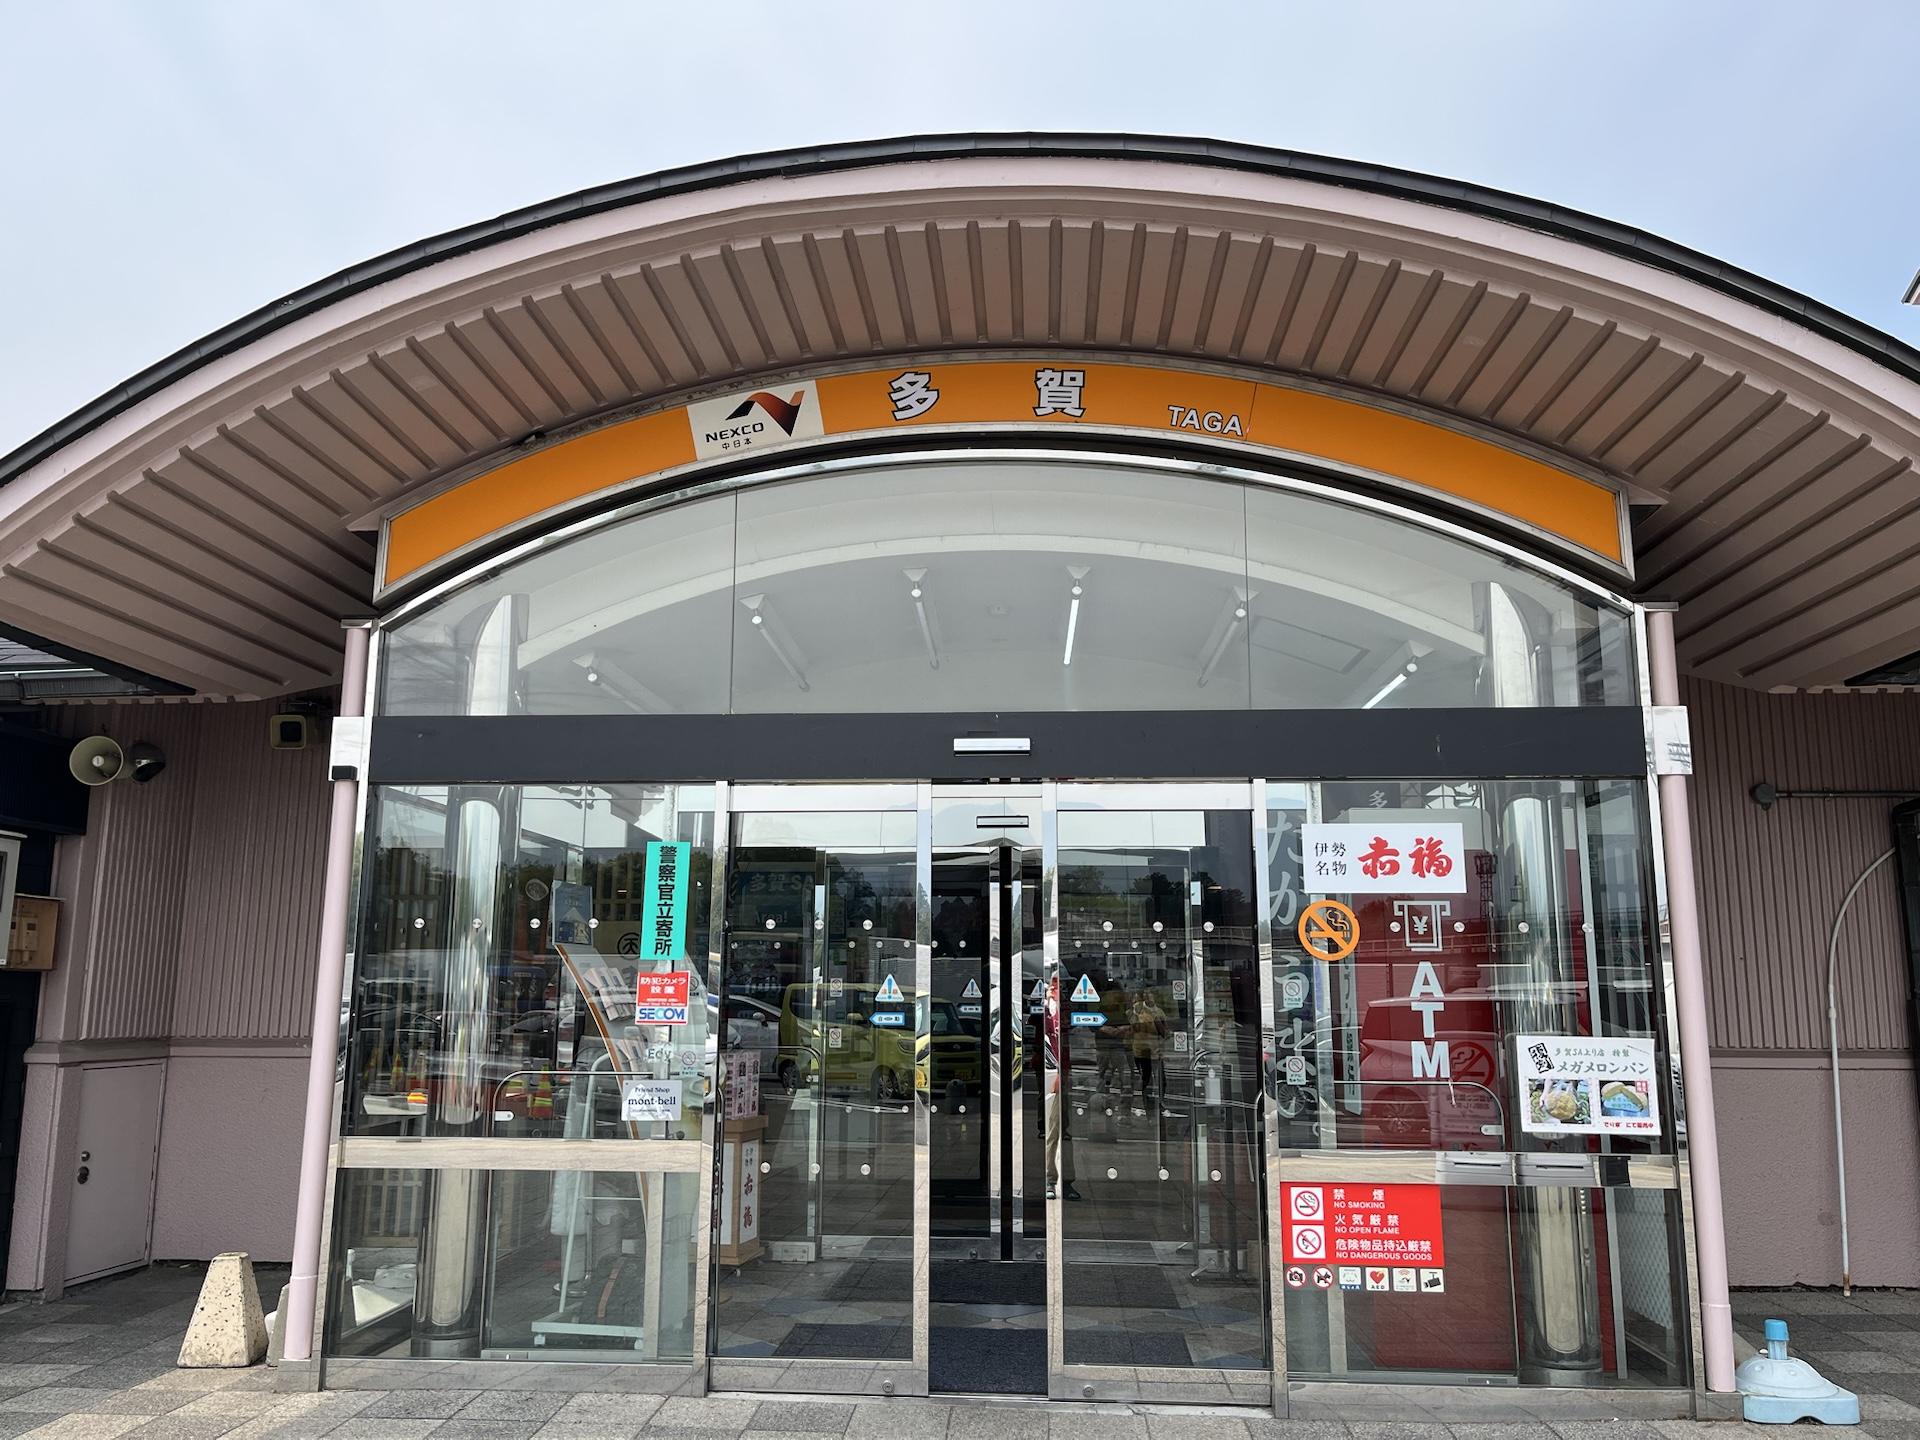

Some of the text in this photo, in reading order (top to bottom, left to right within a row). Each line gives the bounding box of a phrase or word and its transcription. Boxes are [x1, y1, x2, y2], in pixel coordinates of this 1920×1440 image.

[889, 369, 1085, 421] 多賀
[1167, 405, 1244, 438] TAGA
[705, 422, 764, 442] NEXCO
[722, 438, 752, 450] 中日本
[1314, 841, 1347, 857] 伊勢
[1358, 836, 1454, 879] 赤福
[1314, 861, 1347, 876] 名物
[654, 845, 678, 956] 警察官立寄所
[640, 976, 687, 985] 防犯カメラ
[639, 1008, 685, 1020] SECOM
[1409, 961, 1451, 1079] ATM
[1556, 1060, 1650, 1074] メガメロンパン
[655, 1086, 670, 1094] Shop
[1333, 1188, 1385, 1201] 禁煙
[1335, 1214, 1400, 1226] 火気厳禁
[1373, 1227, 1400, 1235] FLAME
[1335, 1239, 1432, 1252] 危険物品持込厳禁
[1350, 1252, 1401, 1260] DANGEROUS
[1402, 1253, 1432, 1261] GOODS
